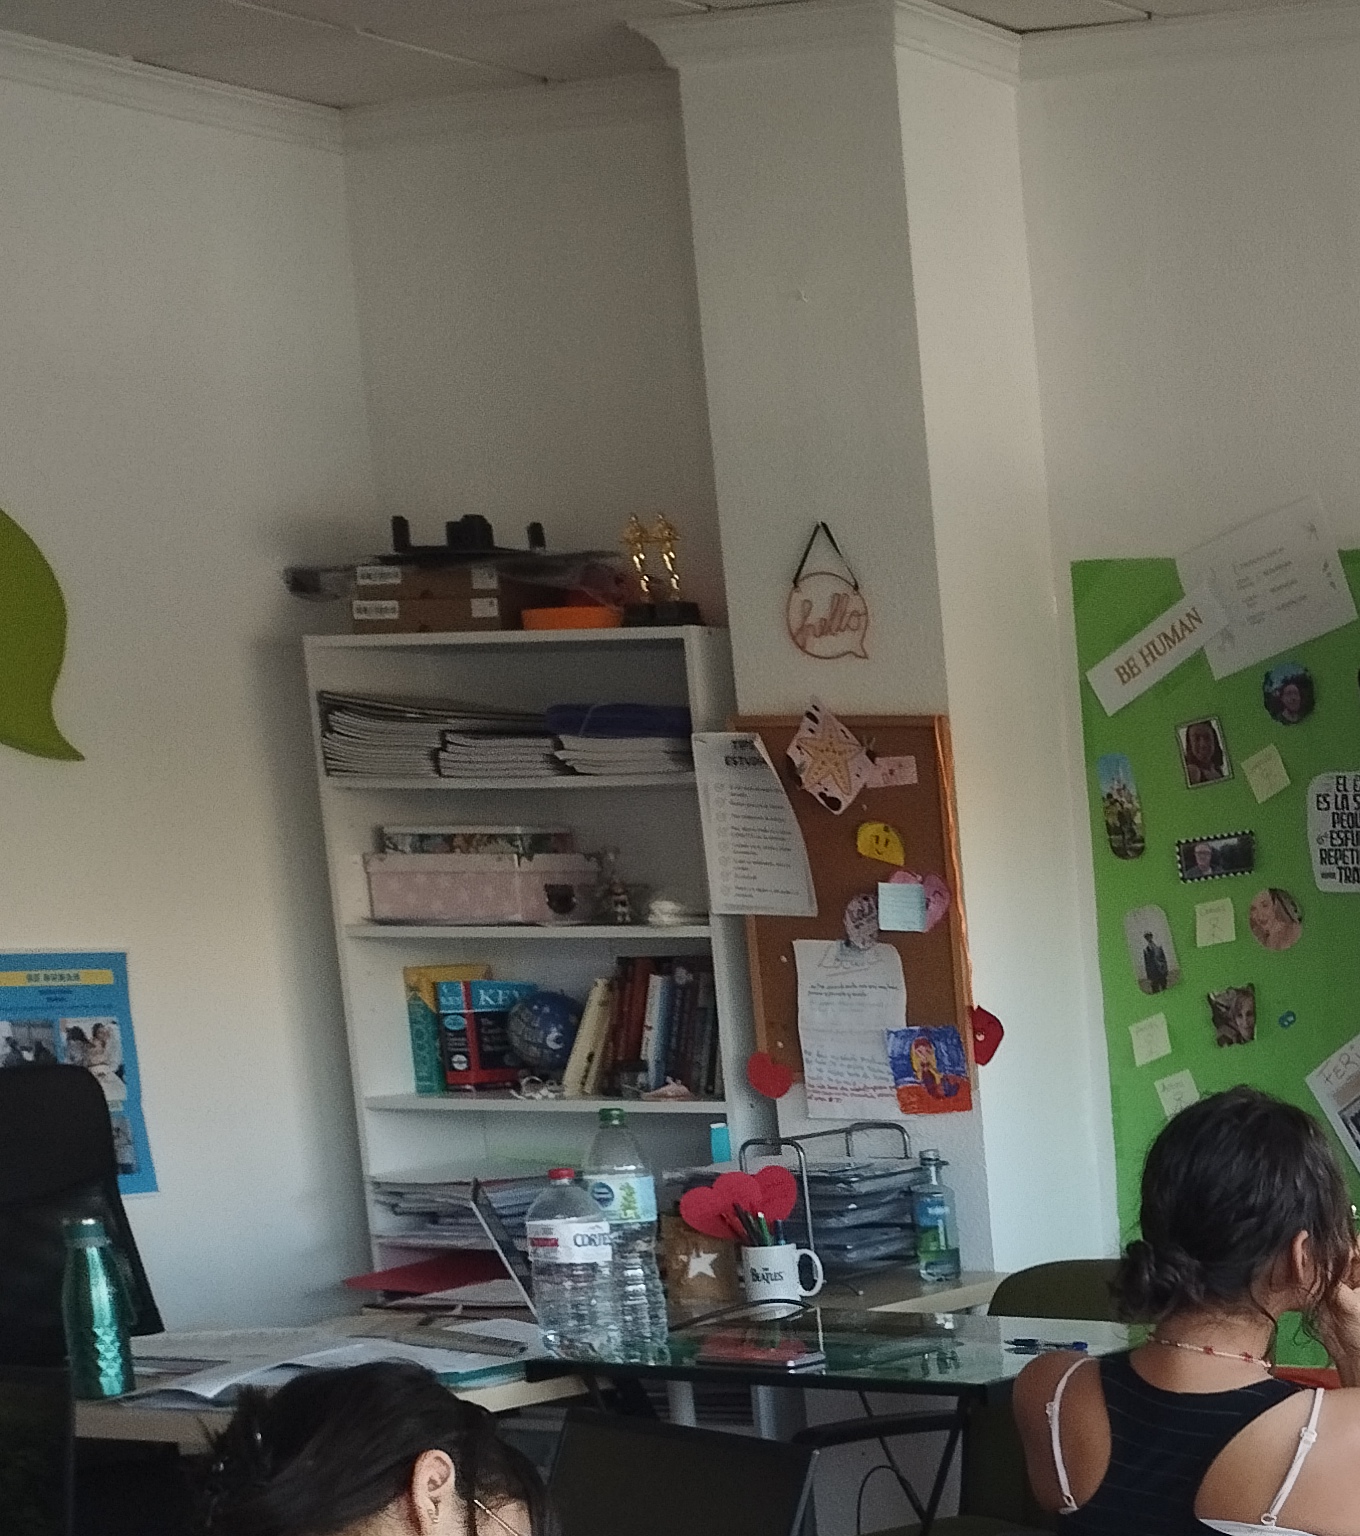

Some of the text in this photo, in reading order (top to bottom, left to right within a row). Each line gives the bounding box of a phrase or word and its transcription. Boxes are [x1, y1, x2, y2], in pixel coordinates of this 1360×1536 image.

[797, 592, 864, 647] hello
[1114, 608, 1205, 687] BE HUMAN
[1316, 793, 1330, 811] ES
[1334, 793, 1350, 811] LA
[1335, 775, 1348, 793] EL
